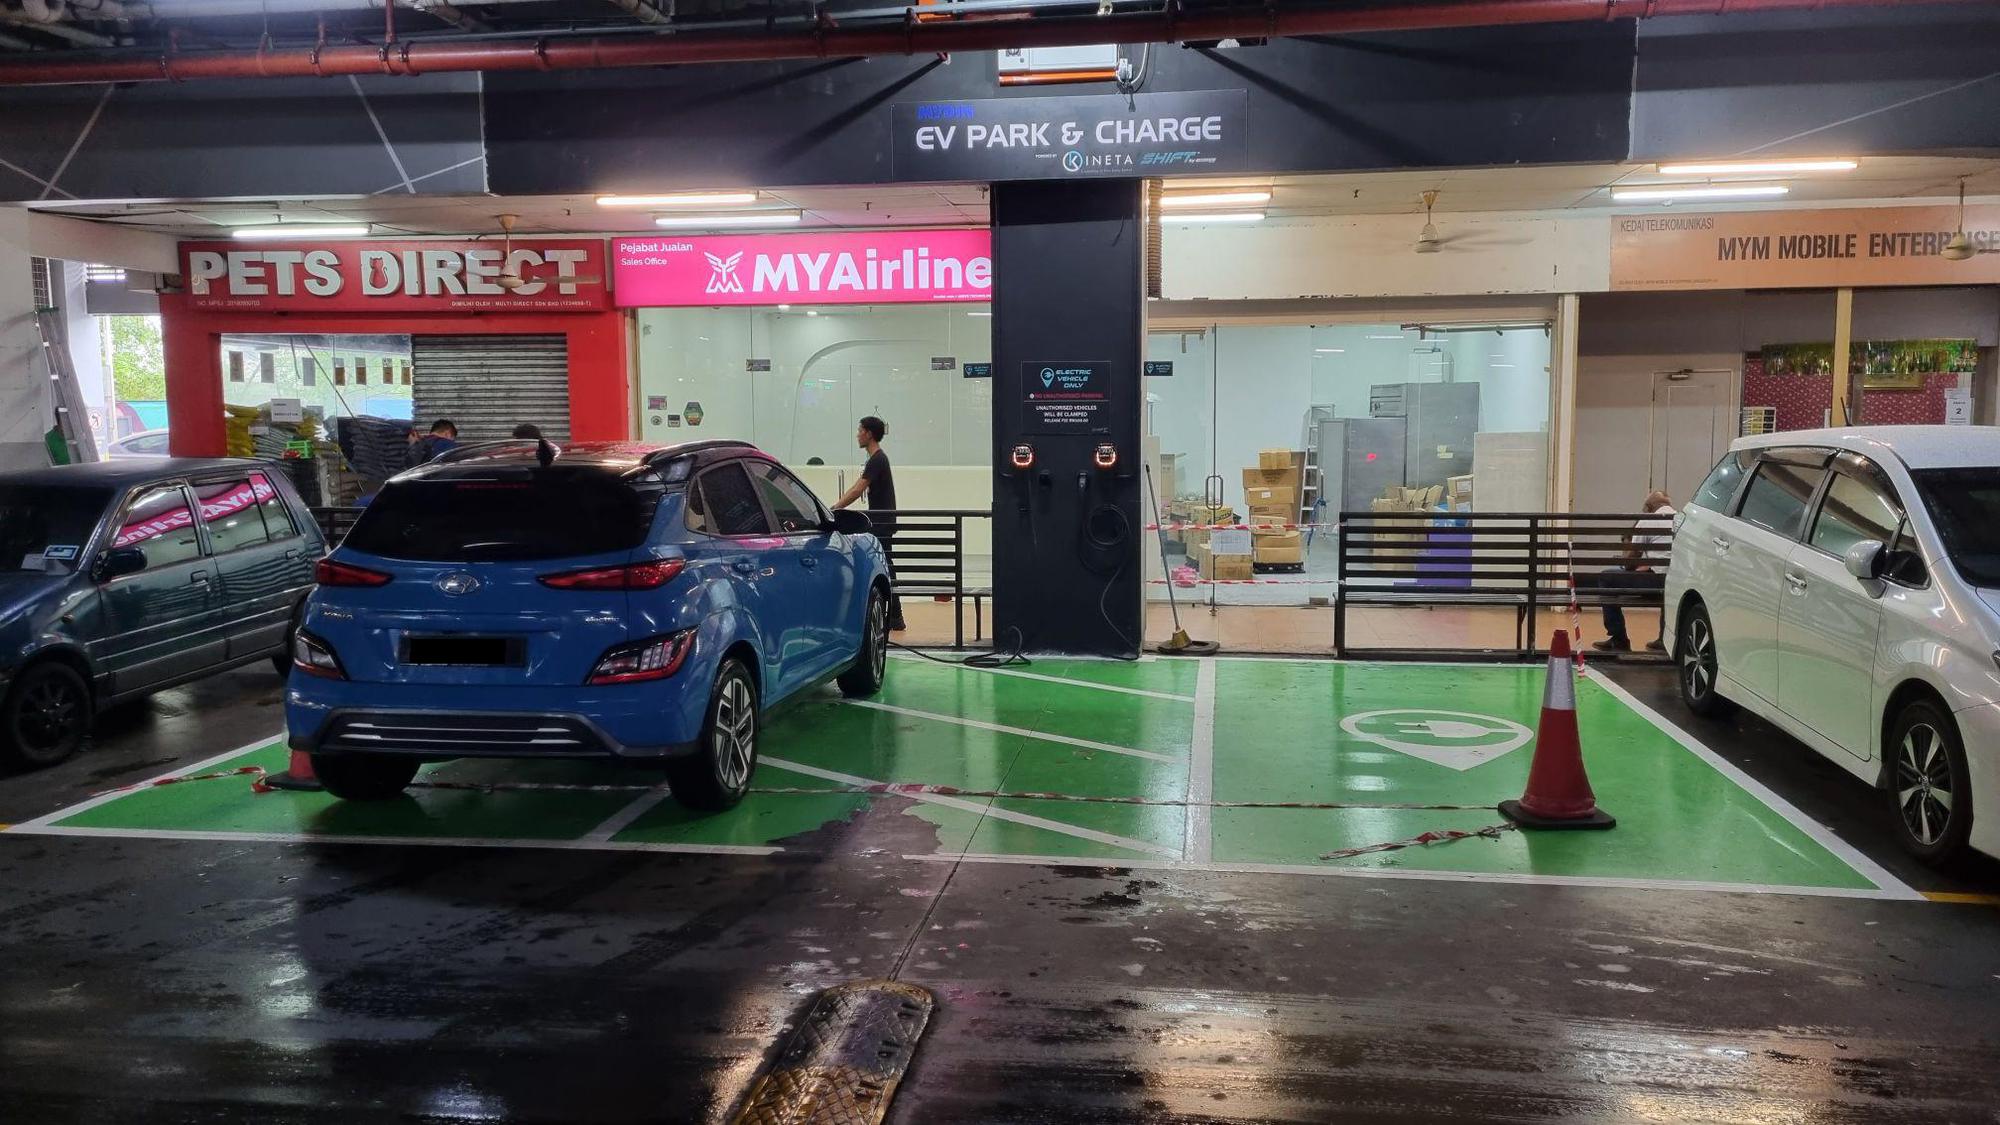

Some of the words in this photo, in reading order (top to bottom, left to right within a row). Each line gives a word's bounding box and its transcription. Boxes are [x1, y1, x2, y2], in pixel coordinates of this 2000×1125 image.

[916, 126, 956, 150] EV
[967, 123, 1050, 148] PARK
[1061, 121, 1084, 145] &
[1096, 116, 1221, 143] CHARGE
[1140, 151, 1197, 165] SHIFT
[1620, 219, 1644, 232] KEDAI
[1646, 217, 1713, 231] TELEKOMUNIKASI
[620, 243, 657, 254] Pejabat
[660, 242, 693, 252] Jualan
[1718, 236, 1770, 261] MYM
[1778, 233, 1856, 260] MOBILE
[620, 258, 643, 266] Sales
[644, 257, 667, 265] Office
[752, 247, 992, 292] MYAirline
[189, 250, 343, 296] PETS
[360, 249, 588, 296] DIRECT
